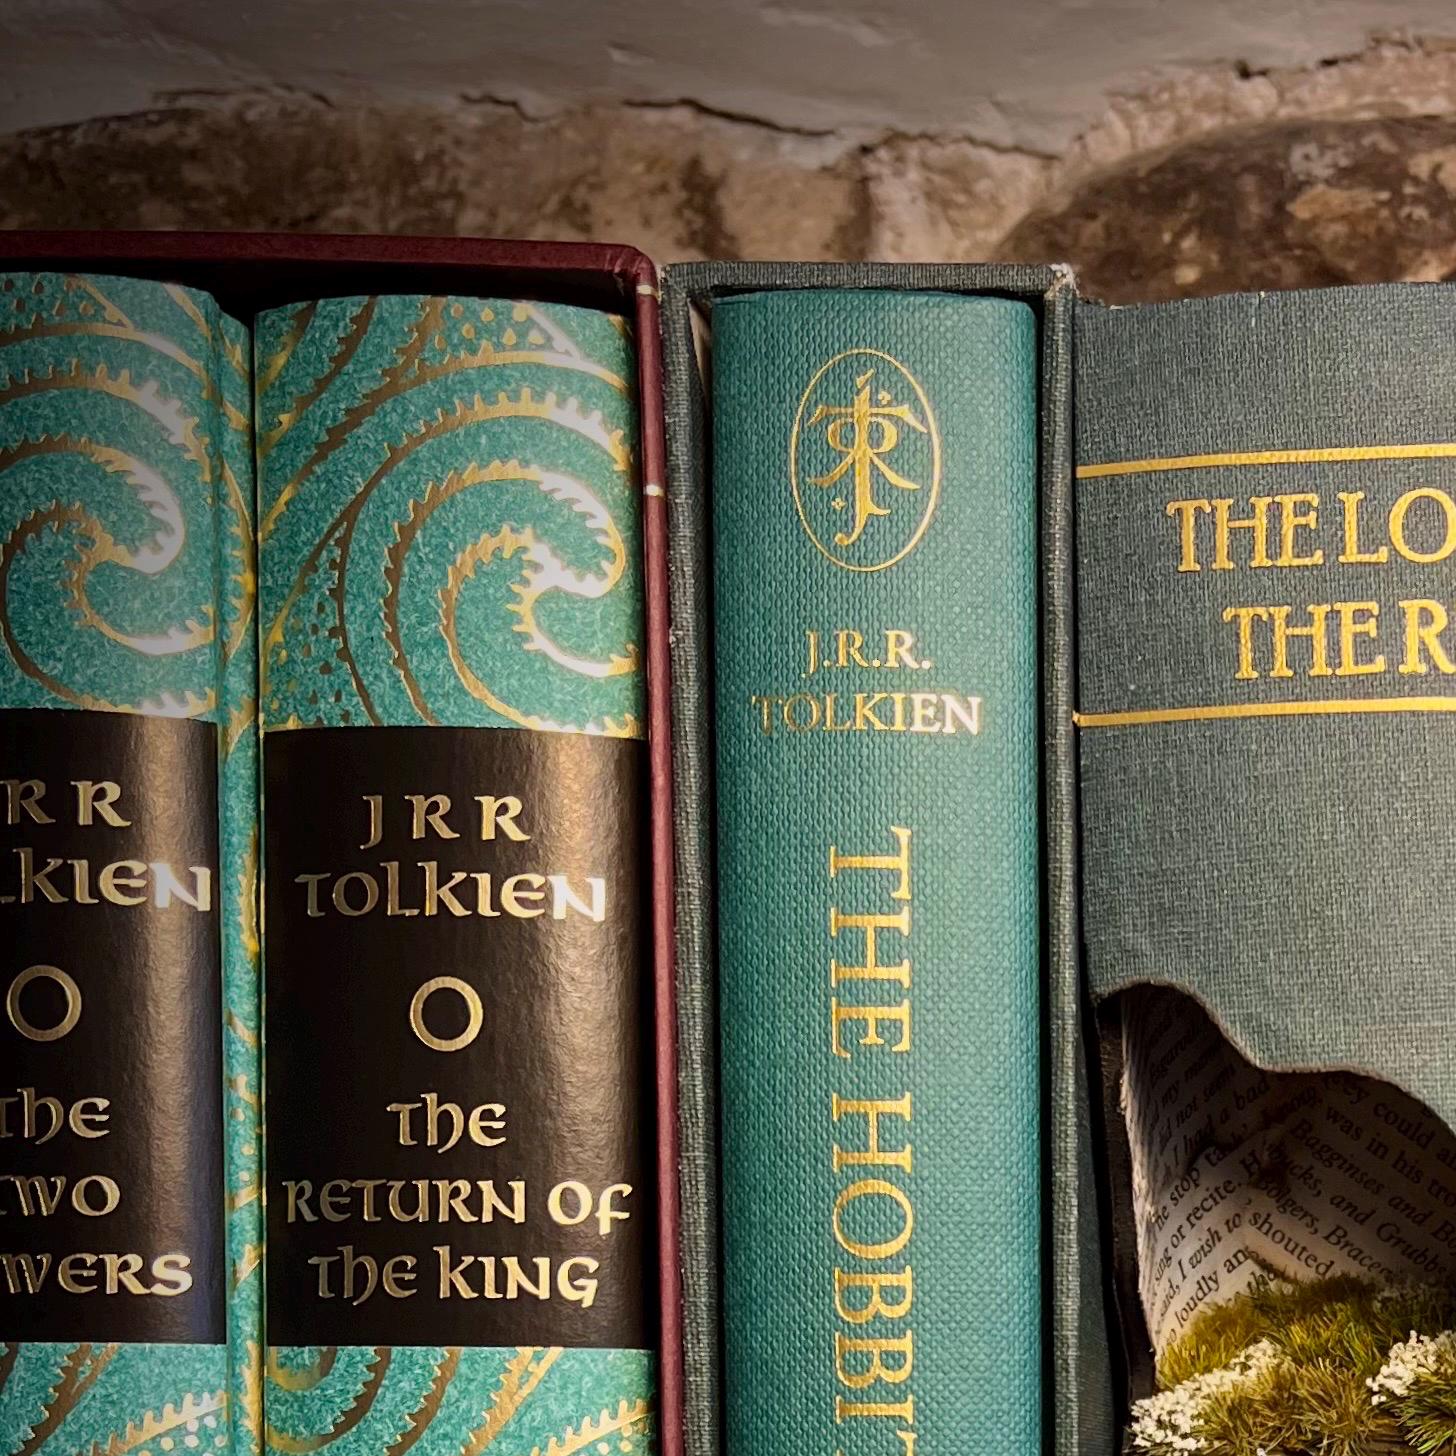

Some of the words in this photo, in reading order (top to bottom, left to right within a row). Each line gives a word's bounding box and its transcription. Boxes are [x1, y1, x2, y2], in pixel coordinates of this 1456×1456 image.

[1165, 492, 1324, 573] THE
[801, 628, 933, 678] J.R.R.
[1222, 601, 1386, 680] THE
[752, 692, 983, 736] TOLKIEN
[828, 825, 913, 1058] THE
[1326, 1106, 1364, 1142] was
[1366, 1130, 1389, 1161] in
[1392, 1150, 1426, 1185] his
[1373, 1102, 1437, 1151] could
[1168, 1166, 1201, 1207] stop
[1290, 1117, 1386, 1197] Bagginses
[1388, 1193, 1434, 1227] and
[1170, 1224, 1186, 1249] or
[1186, 1179, 1242, 1230] recite.
[1249, 1210, 1335, 1277] shouted
[1329, 1193, 1377, 1227] and
[1178, 1258, 1187, 1282] I
[1188, 1227, 1222, 1270] wish
[1224, 1213, 1242, 1234] to
[1175, 1269, 1220, 1329] loudly
